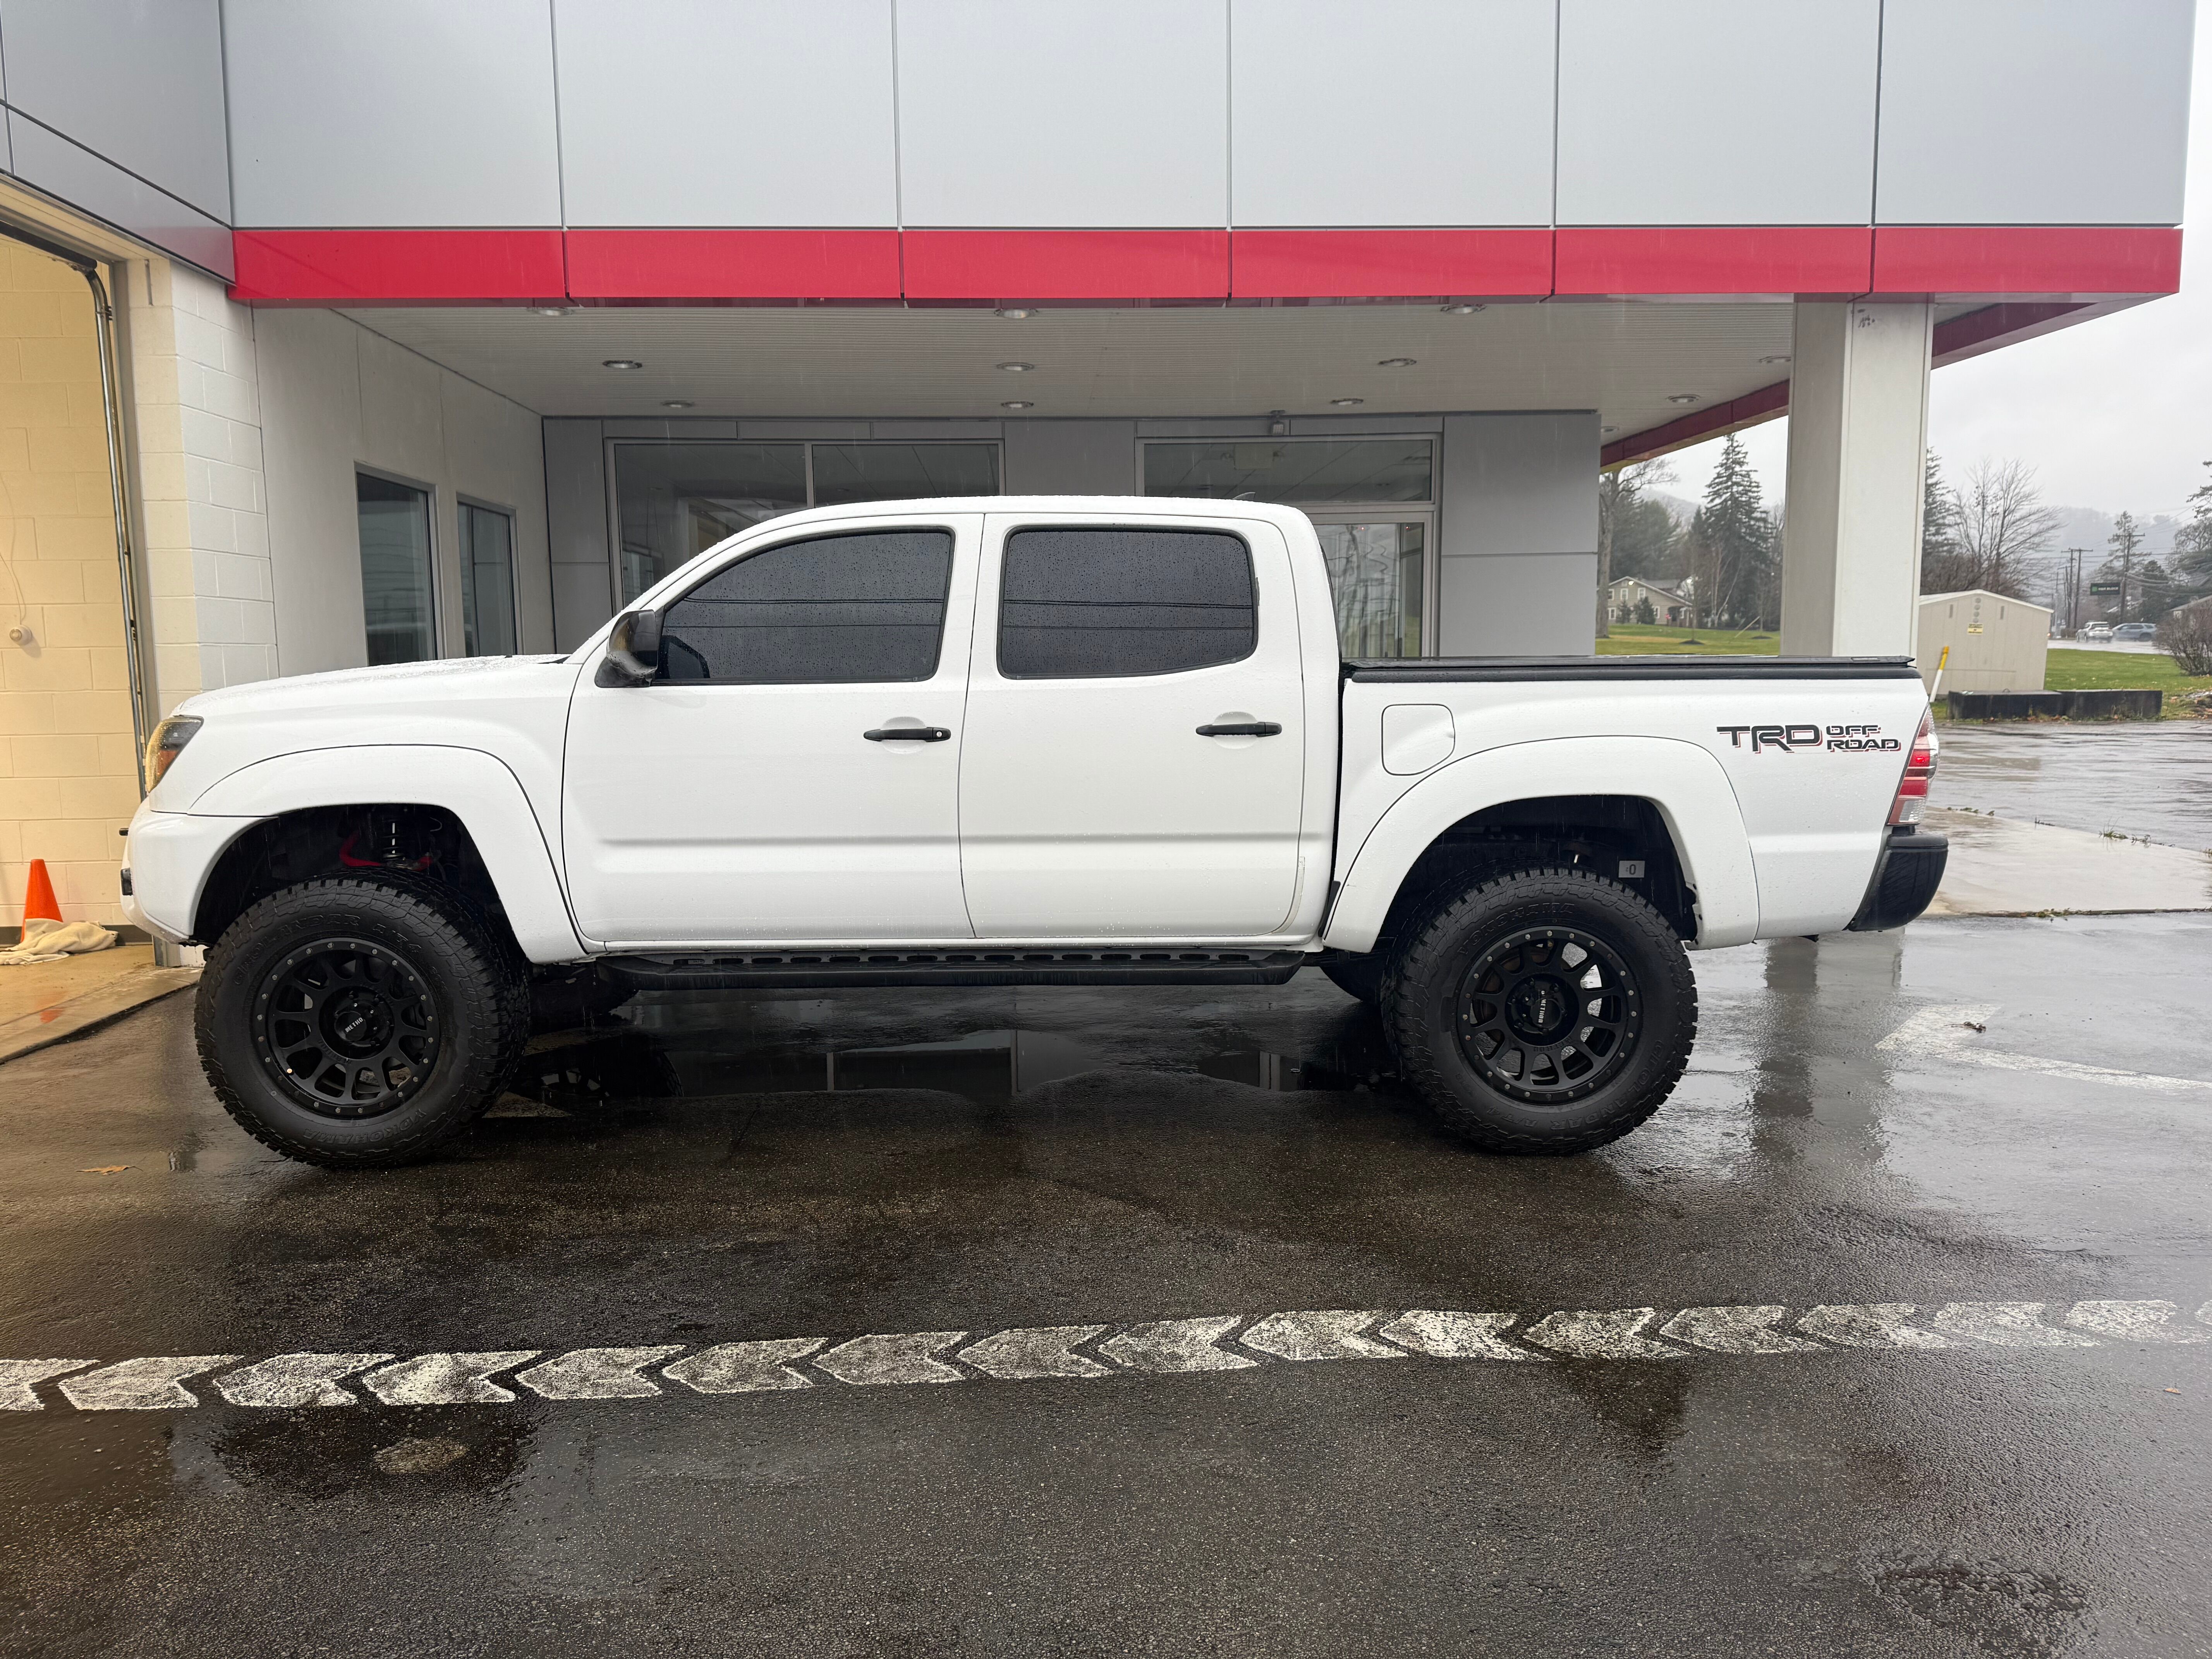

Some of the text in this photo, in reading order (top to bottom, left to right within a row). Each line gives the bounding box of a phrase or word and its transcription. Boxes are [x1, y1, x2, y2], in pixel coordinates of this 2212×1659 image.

[1716, 725, 1822, 753] TRD
[1826, 725, 1881, 737] OFF
[1827, 739, 1901, 752] ROAD
[1538, 998, 1547, 1024] METHOD
[344, 1017, 364, 1033] METHO
[303, 1107, 427, 1145] YOKOHAMA
